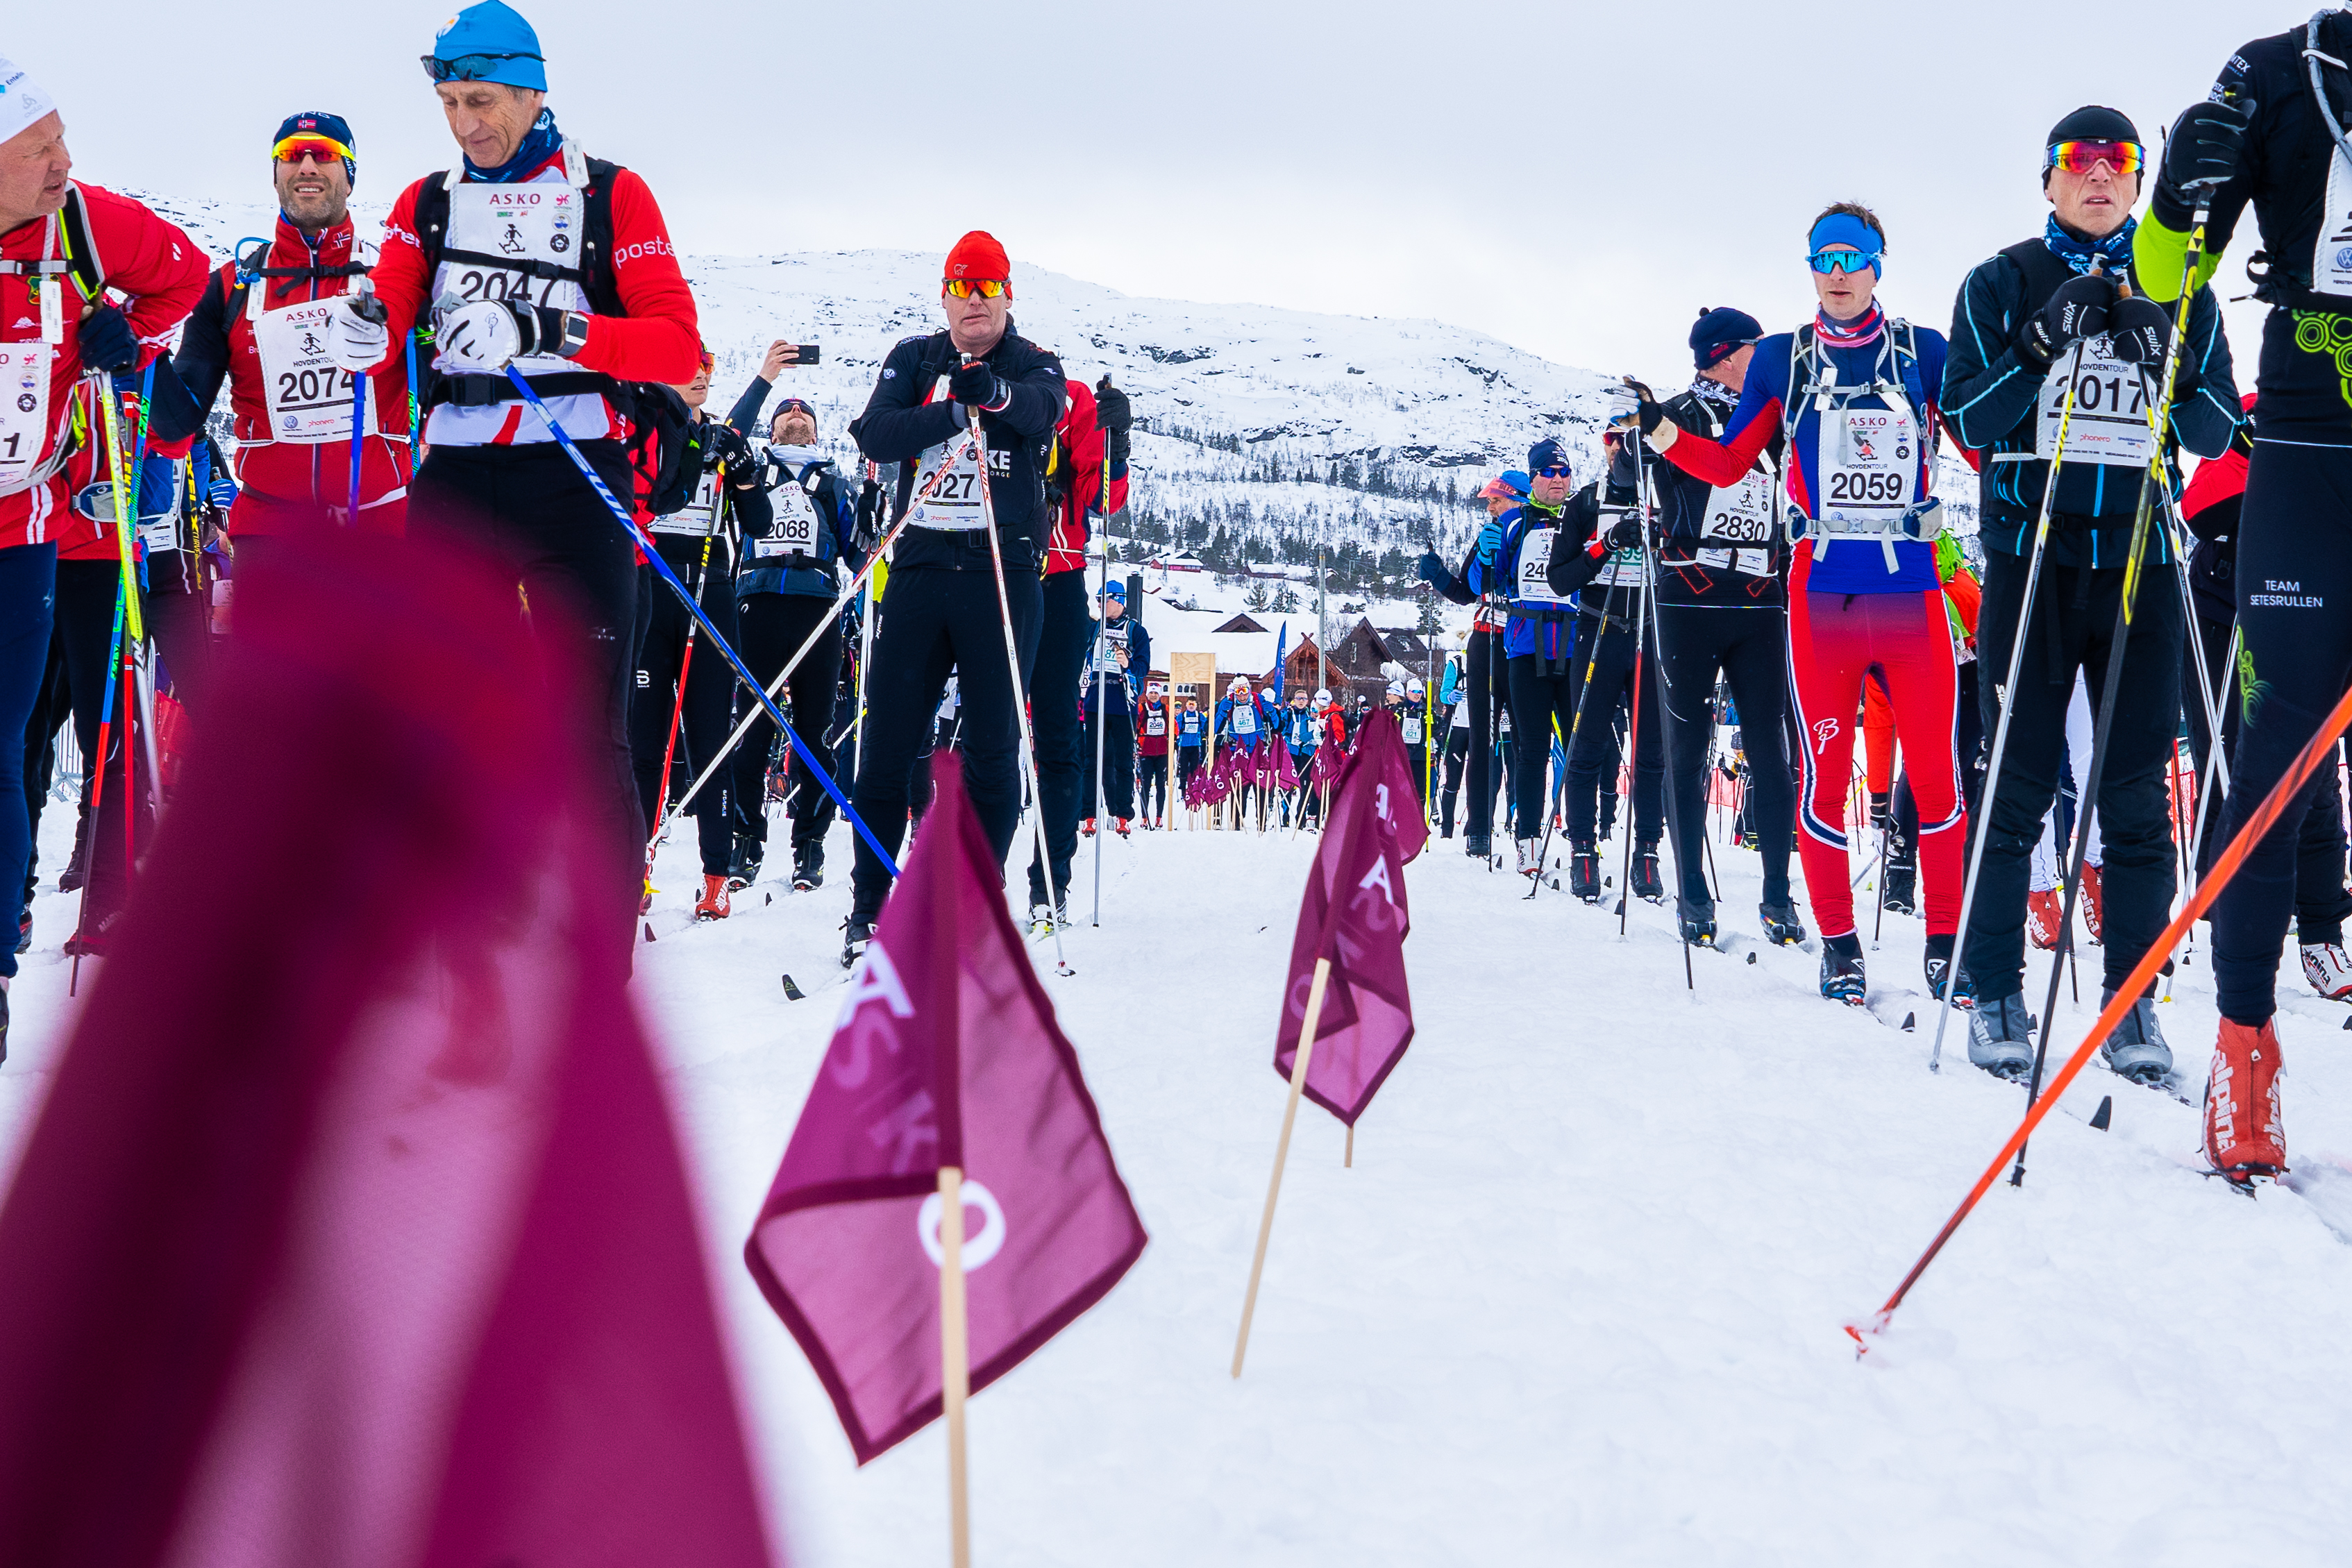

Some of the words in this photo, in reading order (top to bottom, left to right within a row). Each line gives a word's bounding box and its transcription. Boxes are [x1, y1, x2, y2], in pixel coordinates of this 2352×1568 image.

[489, 193, 541, 205] ASKO
[286, 307, 327, 323] ASKO
[2063, 301, 2077, 335] swix
[2035, 321, 2052, 346] swix
[2144, 326, 2162, 356] swix
[278, 366, 356, 403] 2074
[2053, 375, 2142, 414] 2017
[1849, 417, 1887, 426] ASKO
[2080, 433, 2111, 443] phonero
[918, 471, 975, 499] 2027
[1831, 473, 1902, 500] 2059
[1711, 513, 1765, 541] 2830
[2265, 580, 2299, 591] TEAM
[2250, 595, 2323, 607] SETESRULLEN
[2210, 1049, 2237, 1154] alpina
